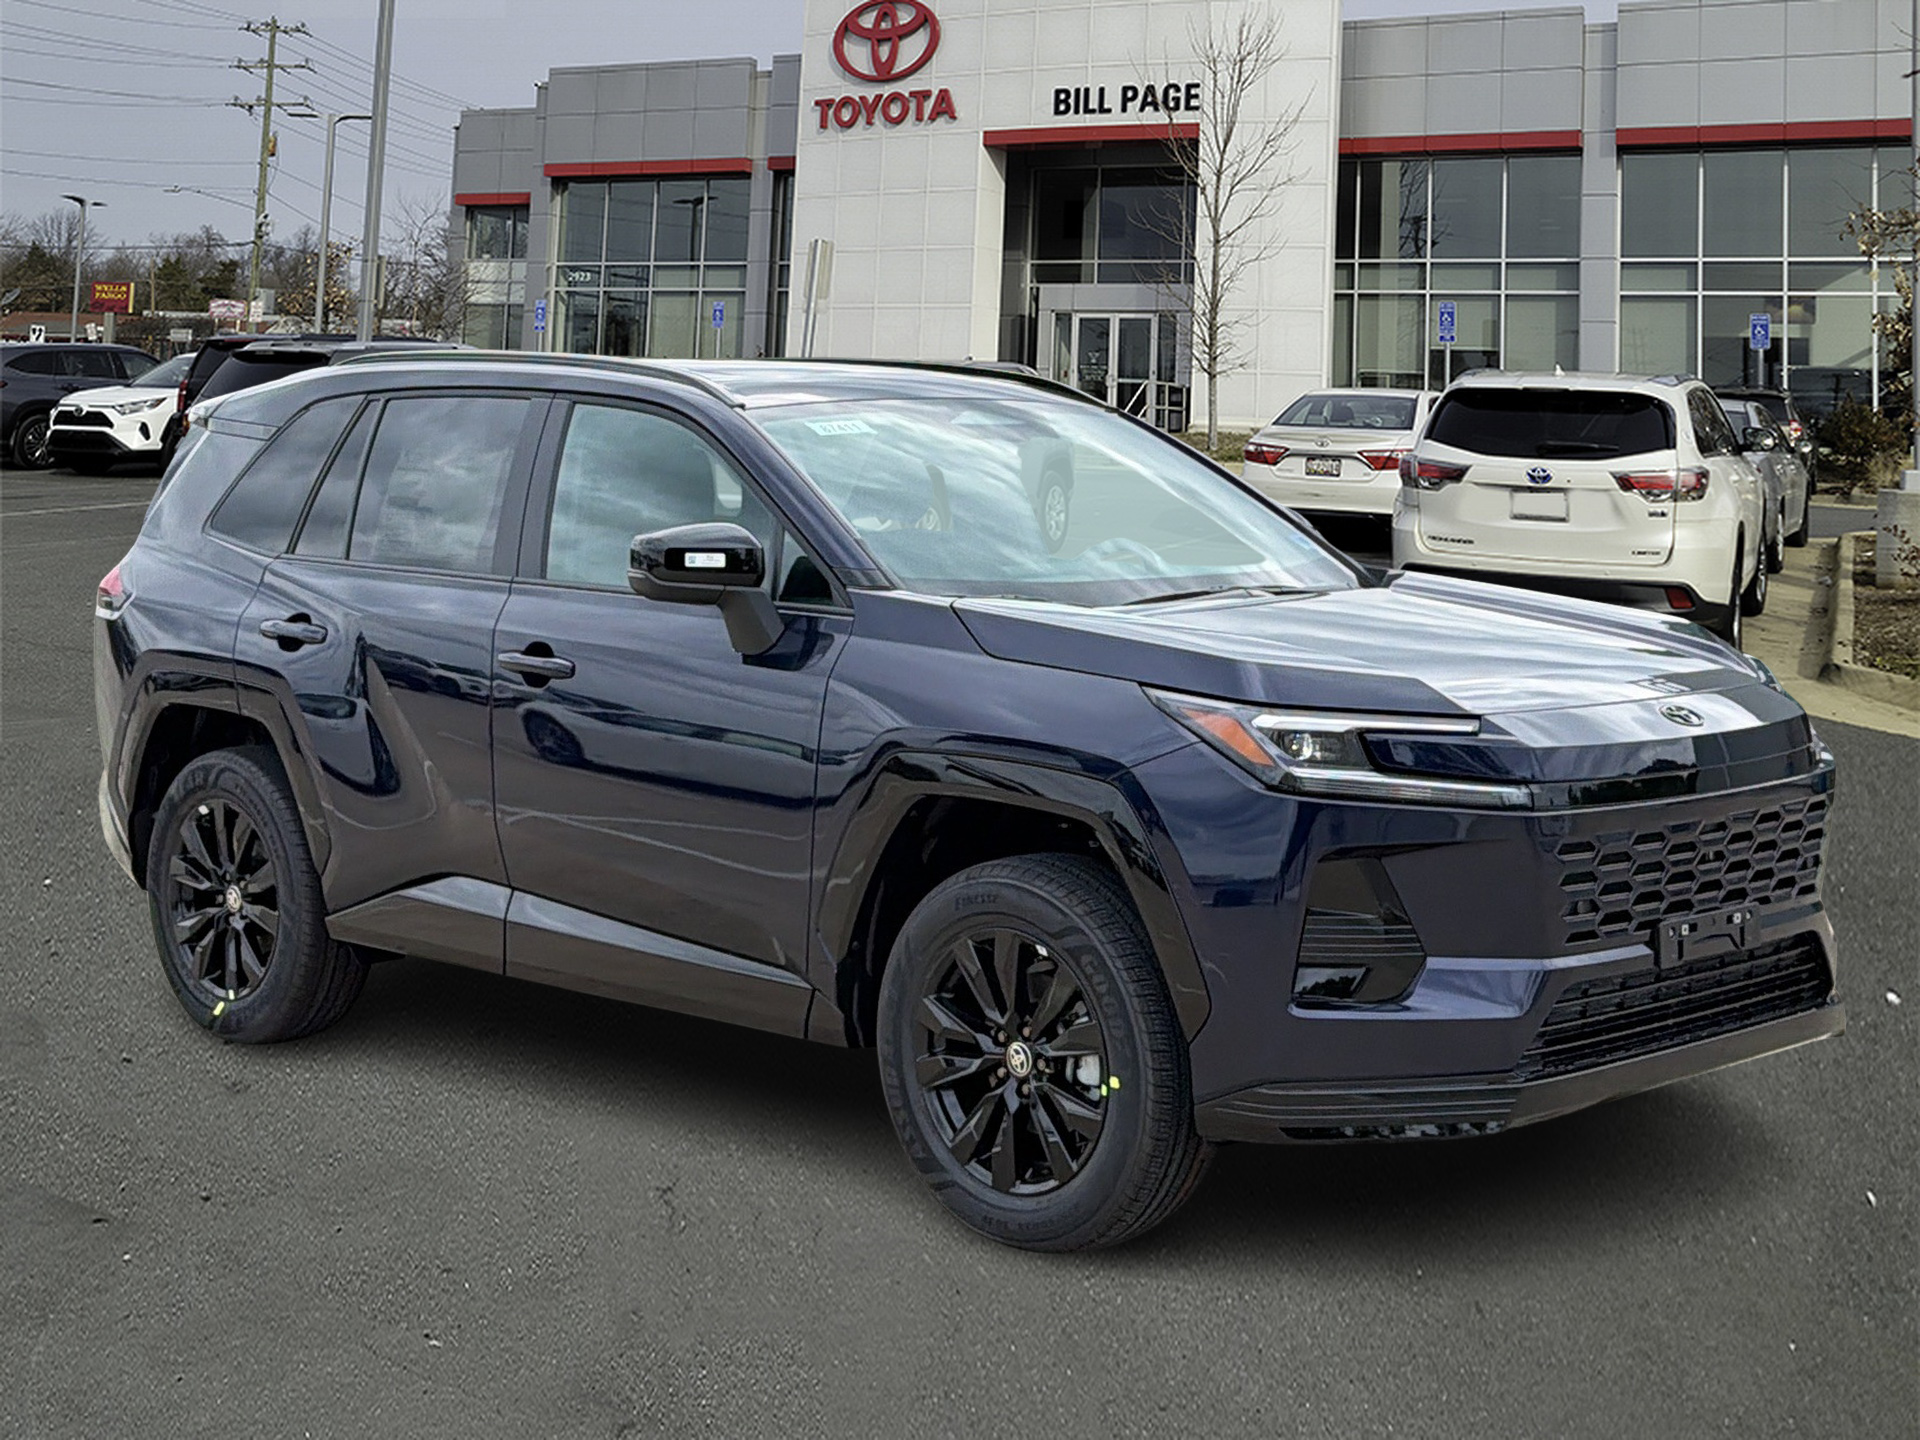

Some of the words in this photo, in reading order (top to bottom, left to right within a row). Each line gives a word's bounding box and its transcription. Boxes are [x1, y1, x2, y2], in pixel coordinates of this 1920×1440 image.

[814, 88, 958, 130] TOYOTA
[1053, 86, 1112, 116] BILL
[1120, 82, 1200, 114] PAGE
[94, 283, 127, 292] WELLS
[94, 291, 128, 300] FARGO
